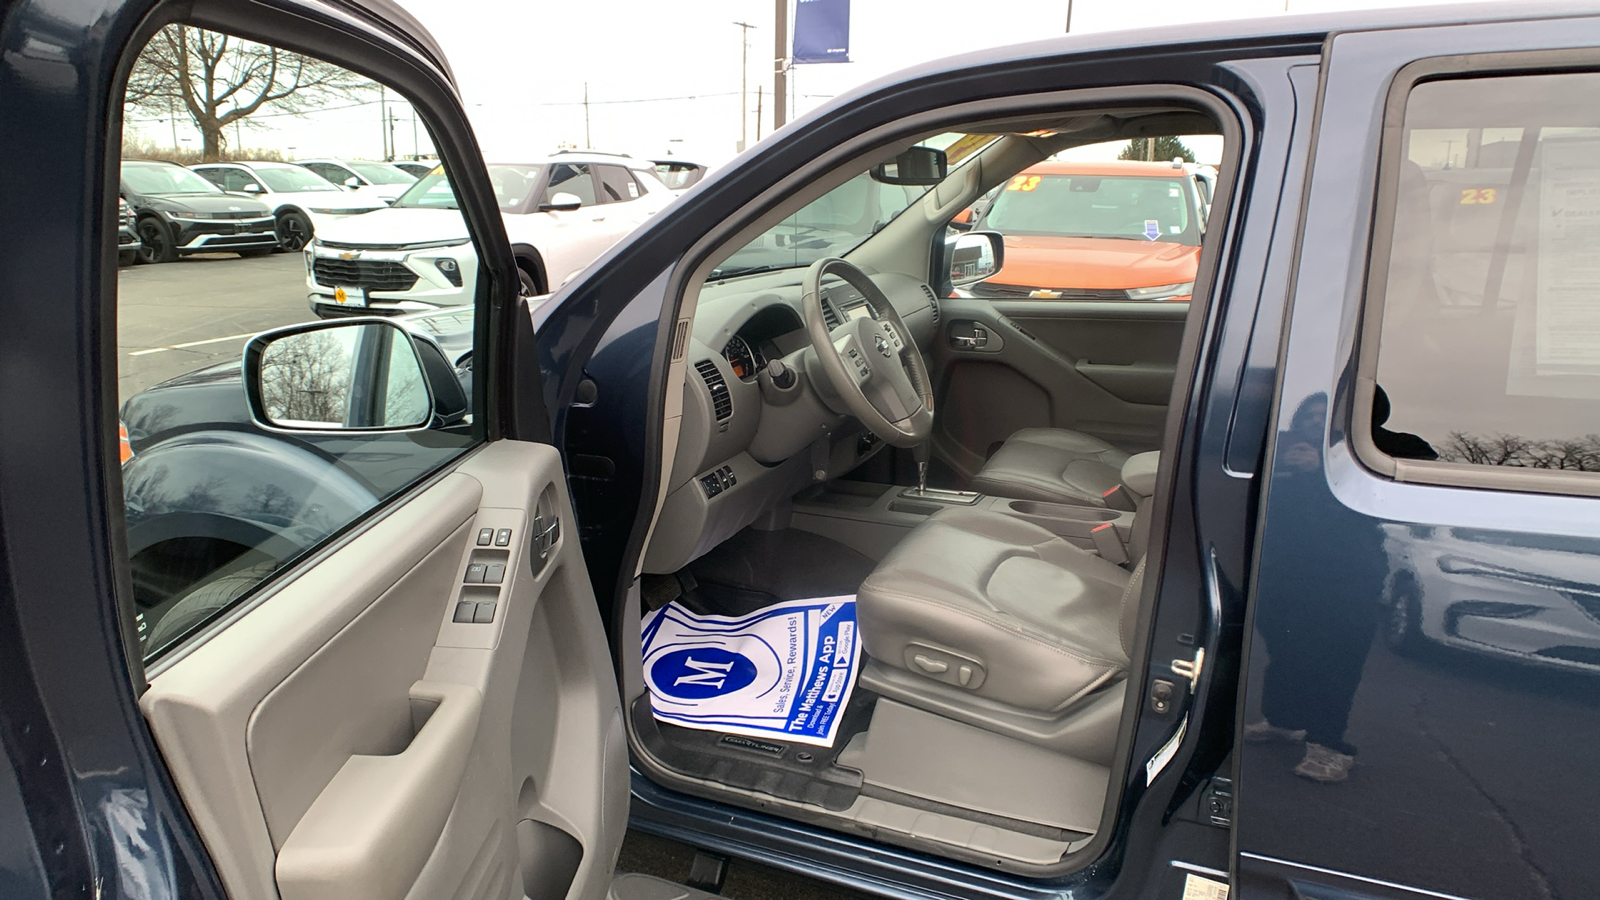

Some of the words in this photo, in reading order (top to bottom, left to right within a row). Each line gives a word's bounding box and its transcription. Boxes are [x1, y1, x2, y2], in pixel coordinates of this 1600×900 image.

[1006, 175, 1041, 191] 23
[1460, 188, 1496, 204] 23
[822, 605, 836, 620] NEW
[786, 616, 798, 665] Rewards!
[819, 635, 836, 664] App
[673, 656, 734, 690] M
[780, 666, 797, 693] Service,
[798, 665, 829, 712] Matthews
[773, 693, 789, 713] Sales,
[788, 712, 809, 732] The
